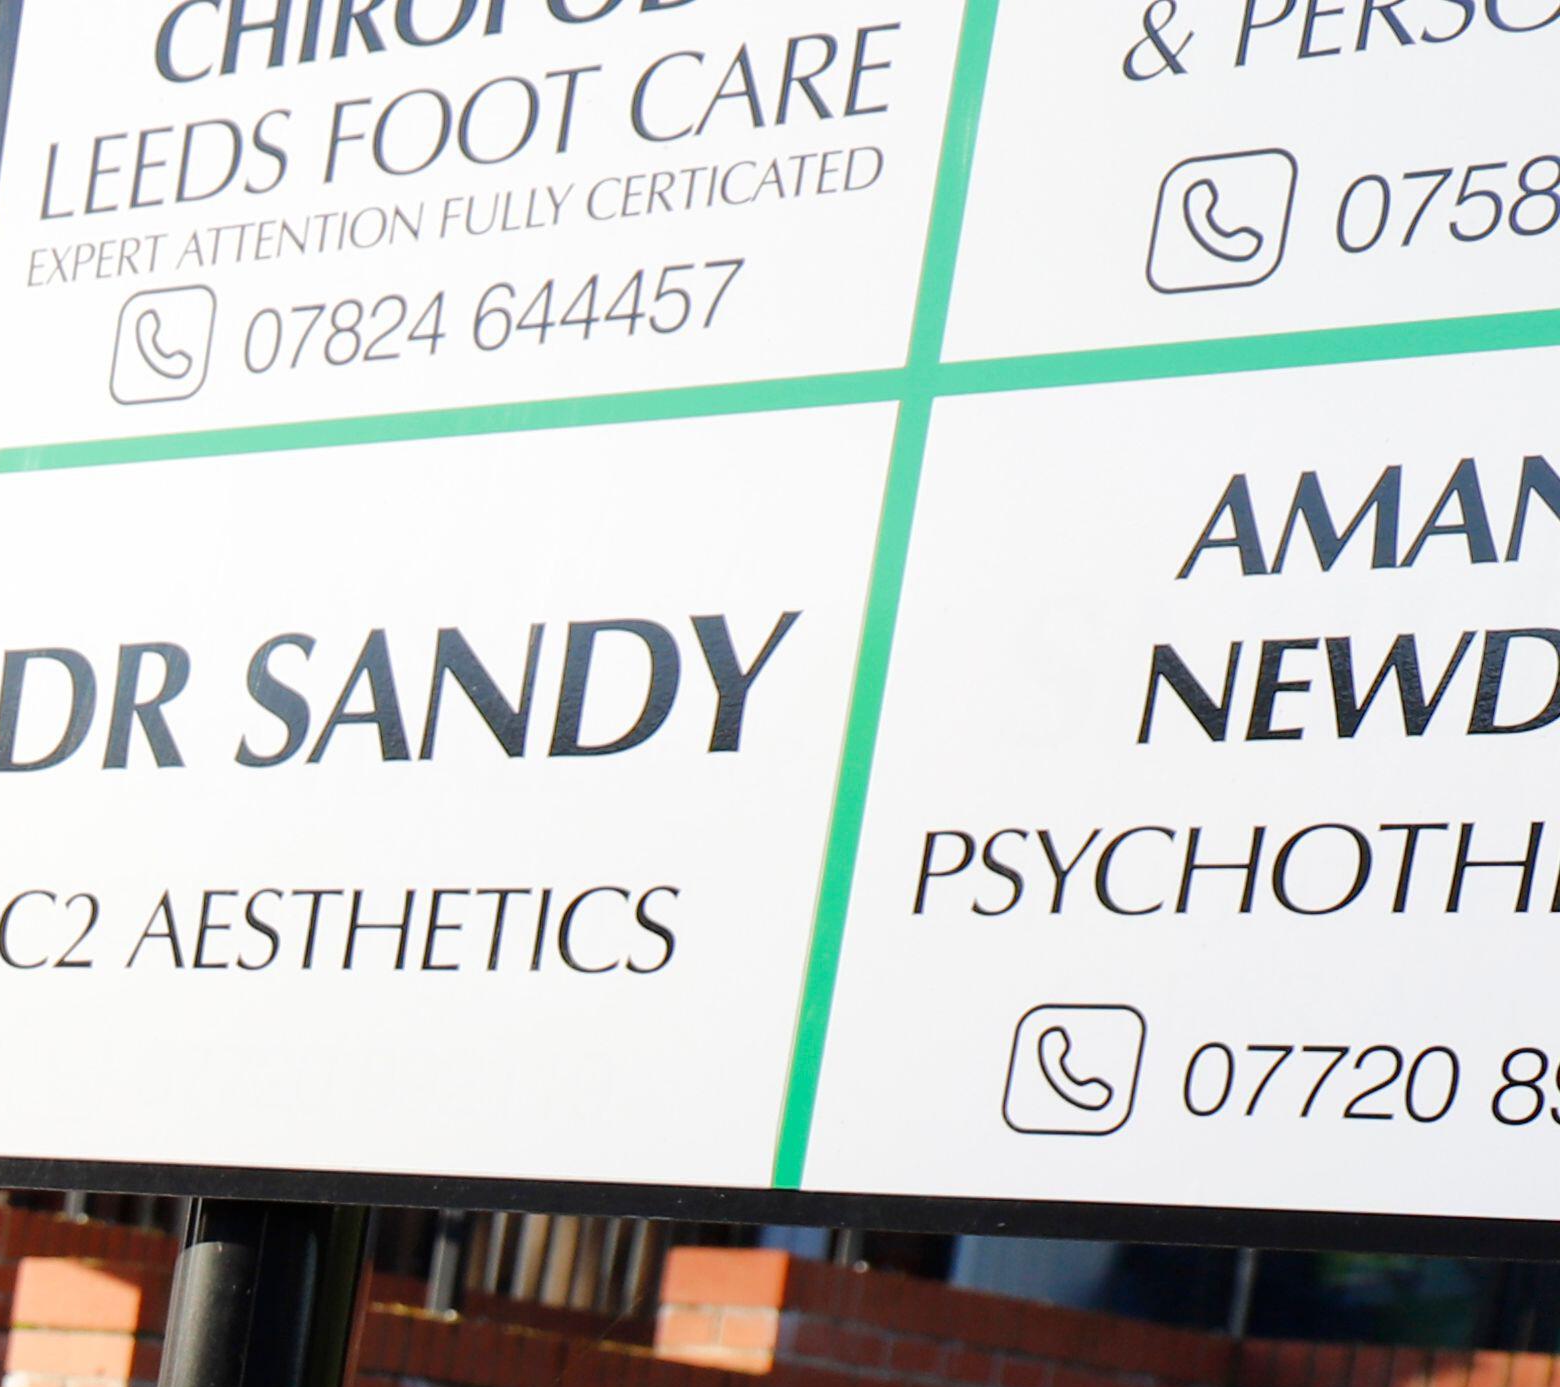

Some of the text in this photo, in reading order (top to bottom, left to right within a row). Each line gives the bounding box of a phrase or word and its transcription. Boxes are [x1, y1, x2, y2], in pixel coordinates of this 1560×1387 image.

[1121, 0, 1194, 82] &
[39, 23, 903, 221] LEEDS FOOT CARE
[26, 146, 885, 287] EXPERT ATTENTION FULLY CERTICATED
[1336, 155, 1560, 254] 0758
[243, 259, 745, 374] 07824 644457
[233, 610, 804, 768] SANDY
[1137, 628, 1560, 743] NEWD
[912, 821, 1560, 916] PSYCHOTH
[125, 885, 682, 974] AESTHETICS
[1183, 1042, 1560, 1126] 07720 8
